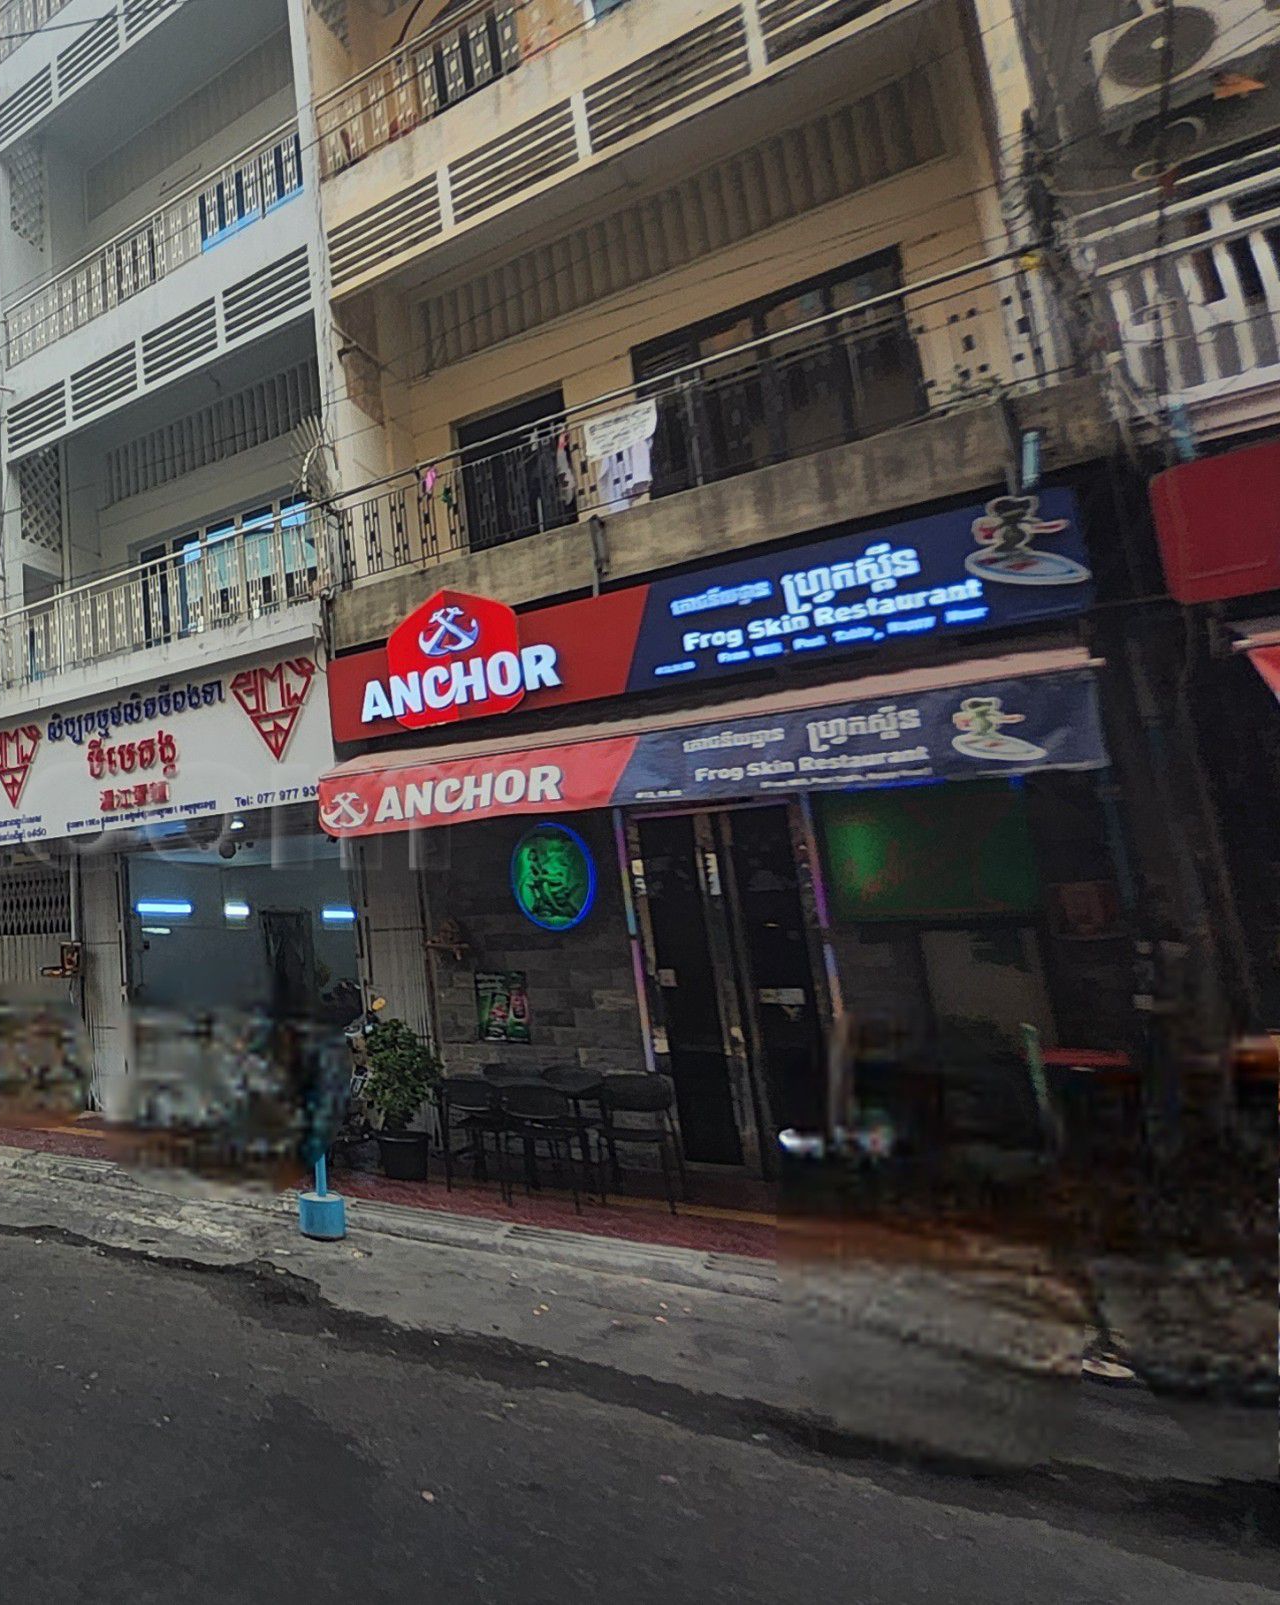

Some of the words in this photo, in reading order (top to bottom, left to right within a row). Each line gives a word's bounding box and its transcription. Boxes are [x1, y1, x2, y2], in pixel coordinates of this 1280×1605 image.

[683, 628, 744, 652] Frog
[747, 617, 809, 640] Skin
[814, 578, 984, 628] Restaurant
[358, 643, 563, 724] ANCHOR
[373, 764, 563, 823] ANCHOR
[694, 767, 744, 783] Frog
[747, 759, 795, 777] Skin
[799, 745, 930, 772] Restaurant
[235, 795, 254, 808] Tel:
[256, 791, 276, 805] 077
[278, 788, 300, 801] 977
